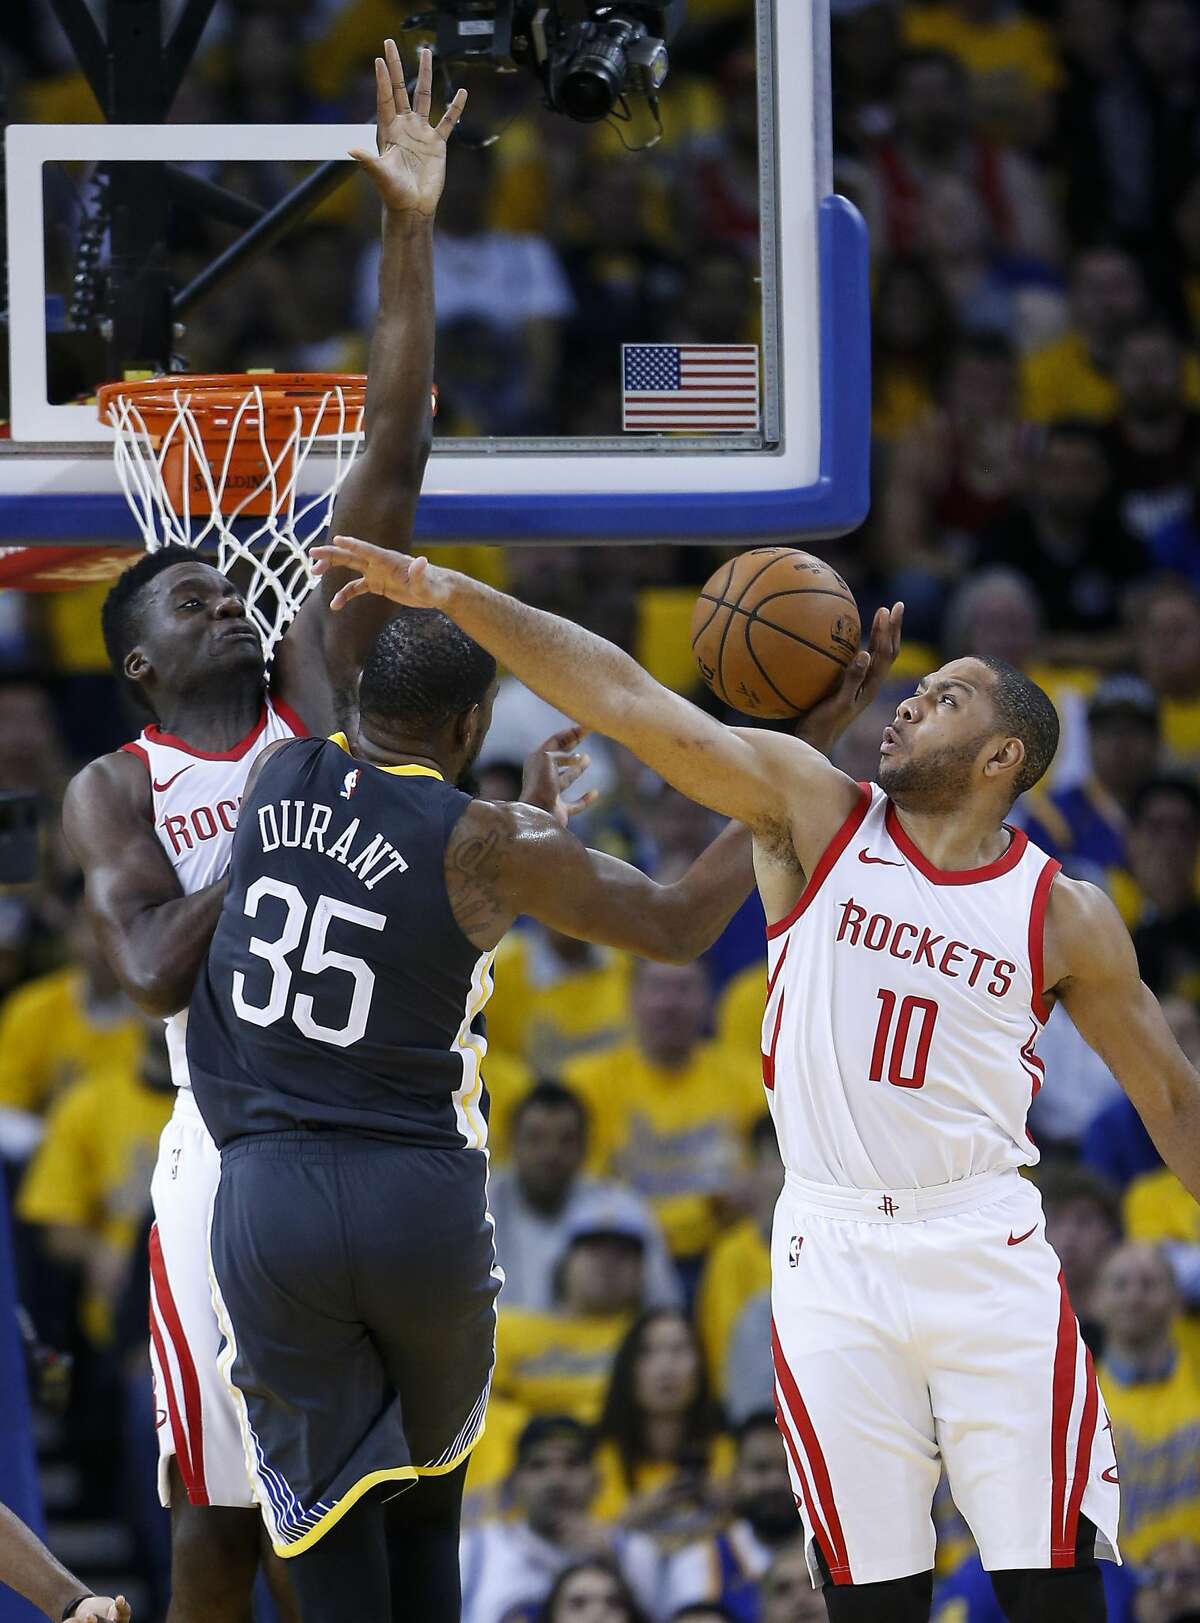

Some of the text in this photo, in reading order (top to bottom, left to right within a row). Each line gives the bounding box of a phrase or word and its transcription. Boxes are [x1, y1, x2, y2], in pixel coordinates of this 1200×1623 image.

[159, 797, 242, 856] ROC
[258, 800, 409, 891] DURANT
[232, 875, 387, 1048] 35
[836, 897, 1016, 997] ROCKETS
[868, 988, 939, 1089] 10
